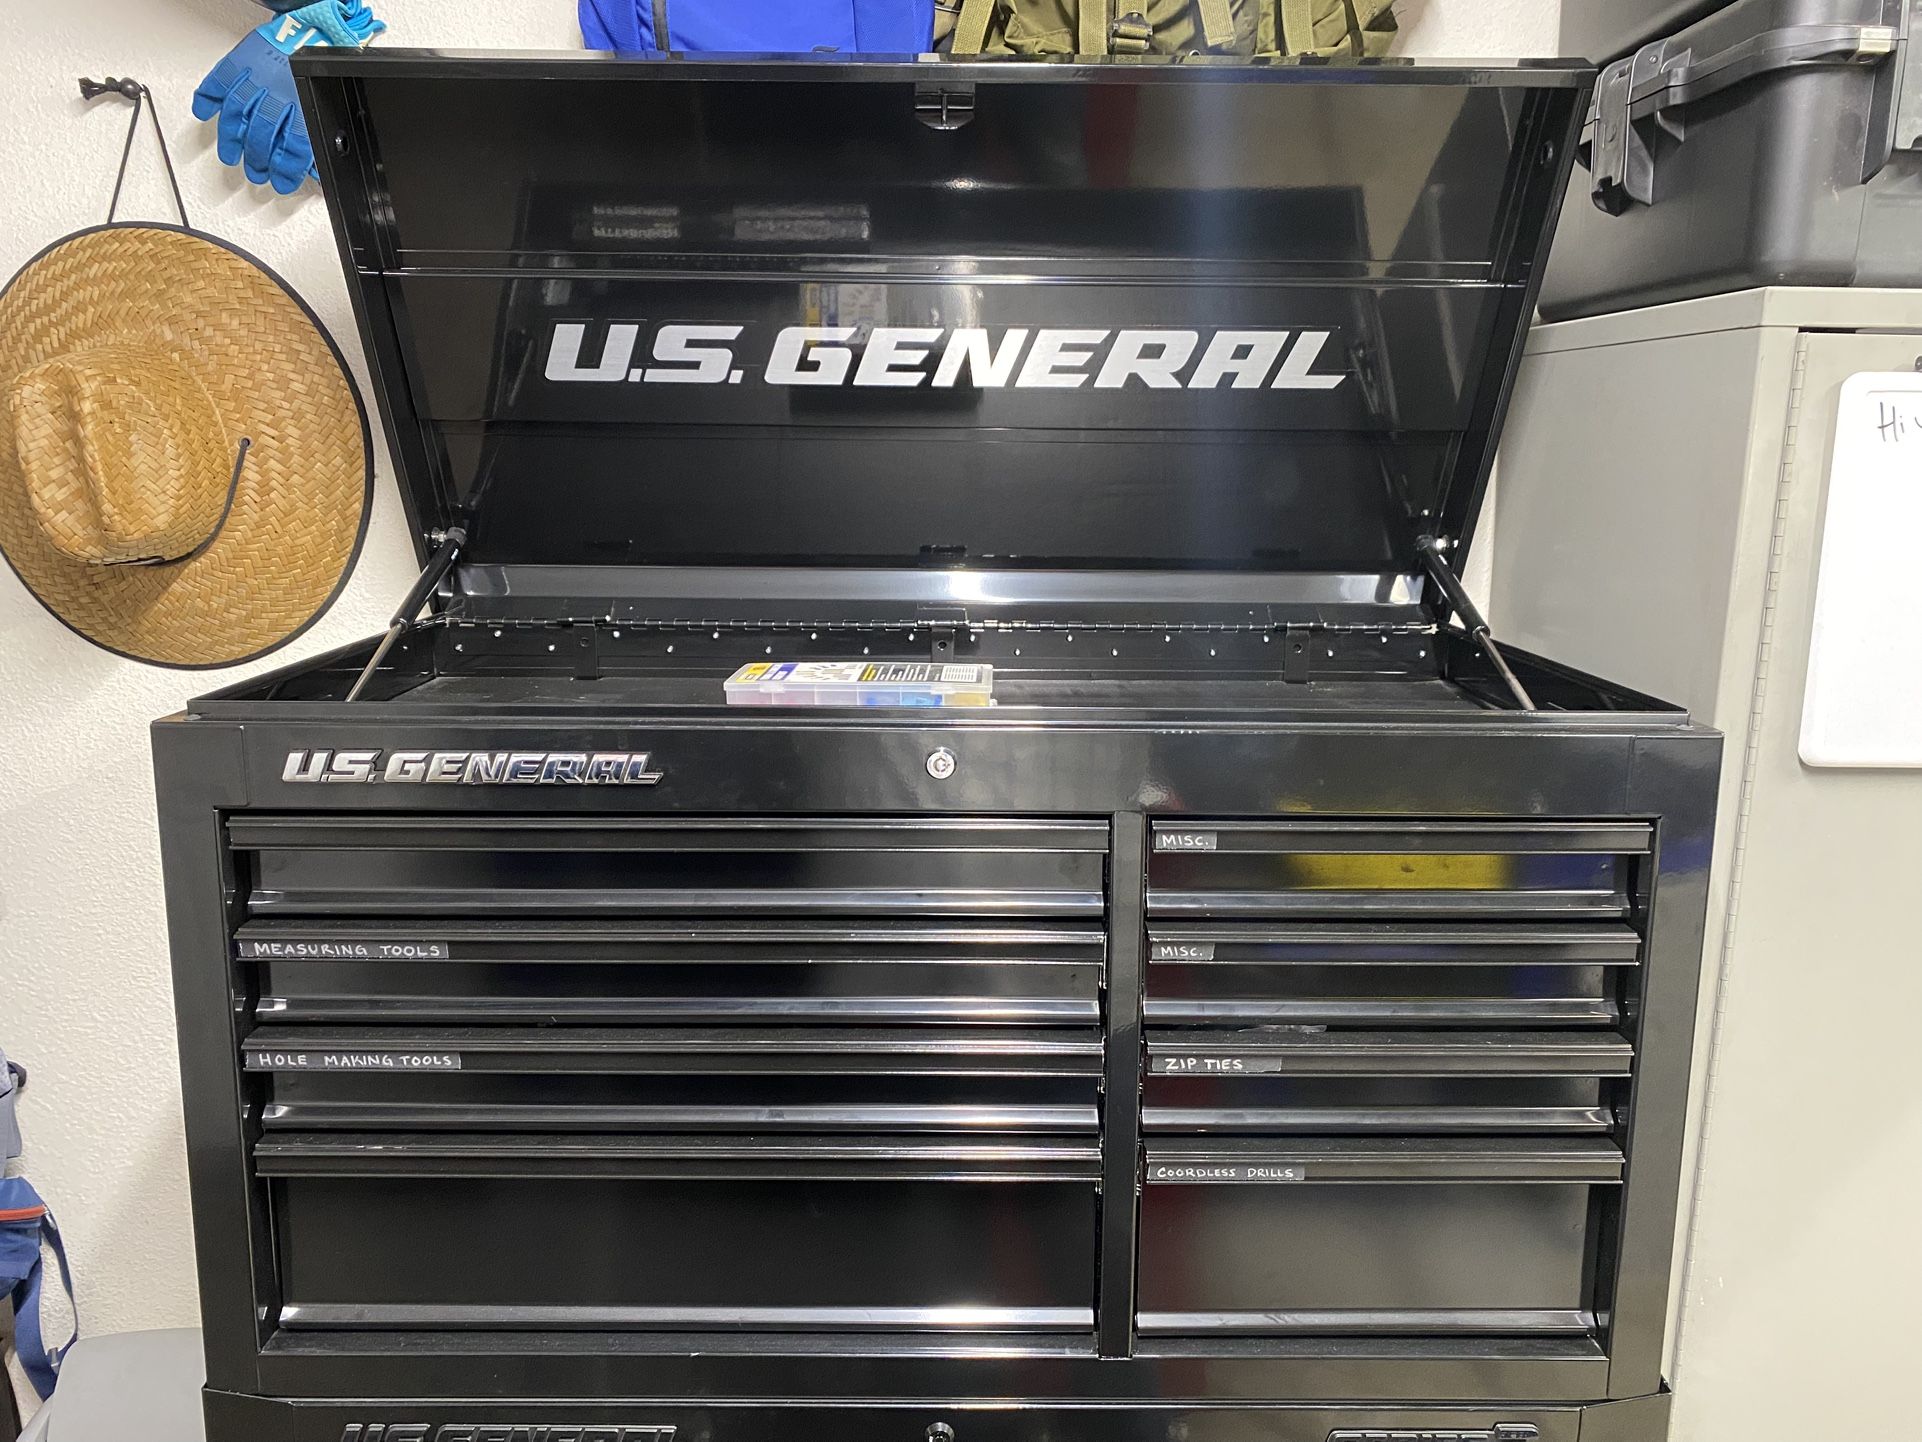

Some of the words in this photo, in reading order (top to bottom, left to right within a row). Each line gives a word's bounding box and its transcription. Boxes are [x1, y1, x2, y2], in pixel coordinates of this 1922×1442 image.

[544, 323, 743, 384] U.S.
[763, 326, 1347, 390] GENERAL
[1877, 402, 1905, 442] Hi
[281, 748, 383, 783] U.S.
[383, 750, 664, 786] GENERAL
[1162, 834, 1209, 847] MISC.
[253, 942, 368, 957] MEASURING
[379, 944, 441, 957] TOOLS
[1160, 946, 1203, 958] MISC.
[258, 1053, 308, 1067] HOLE
[323, 1053, 394, 1068] MAKING
[399, 1055, 453, 1067] TOOLS
[1164, 1058, 1198, 1071] ZIP
[1203, 1058, 1244, 1071] TIES
[1247, 1168, 1294, 1178] DRILLS
